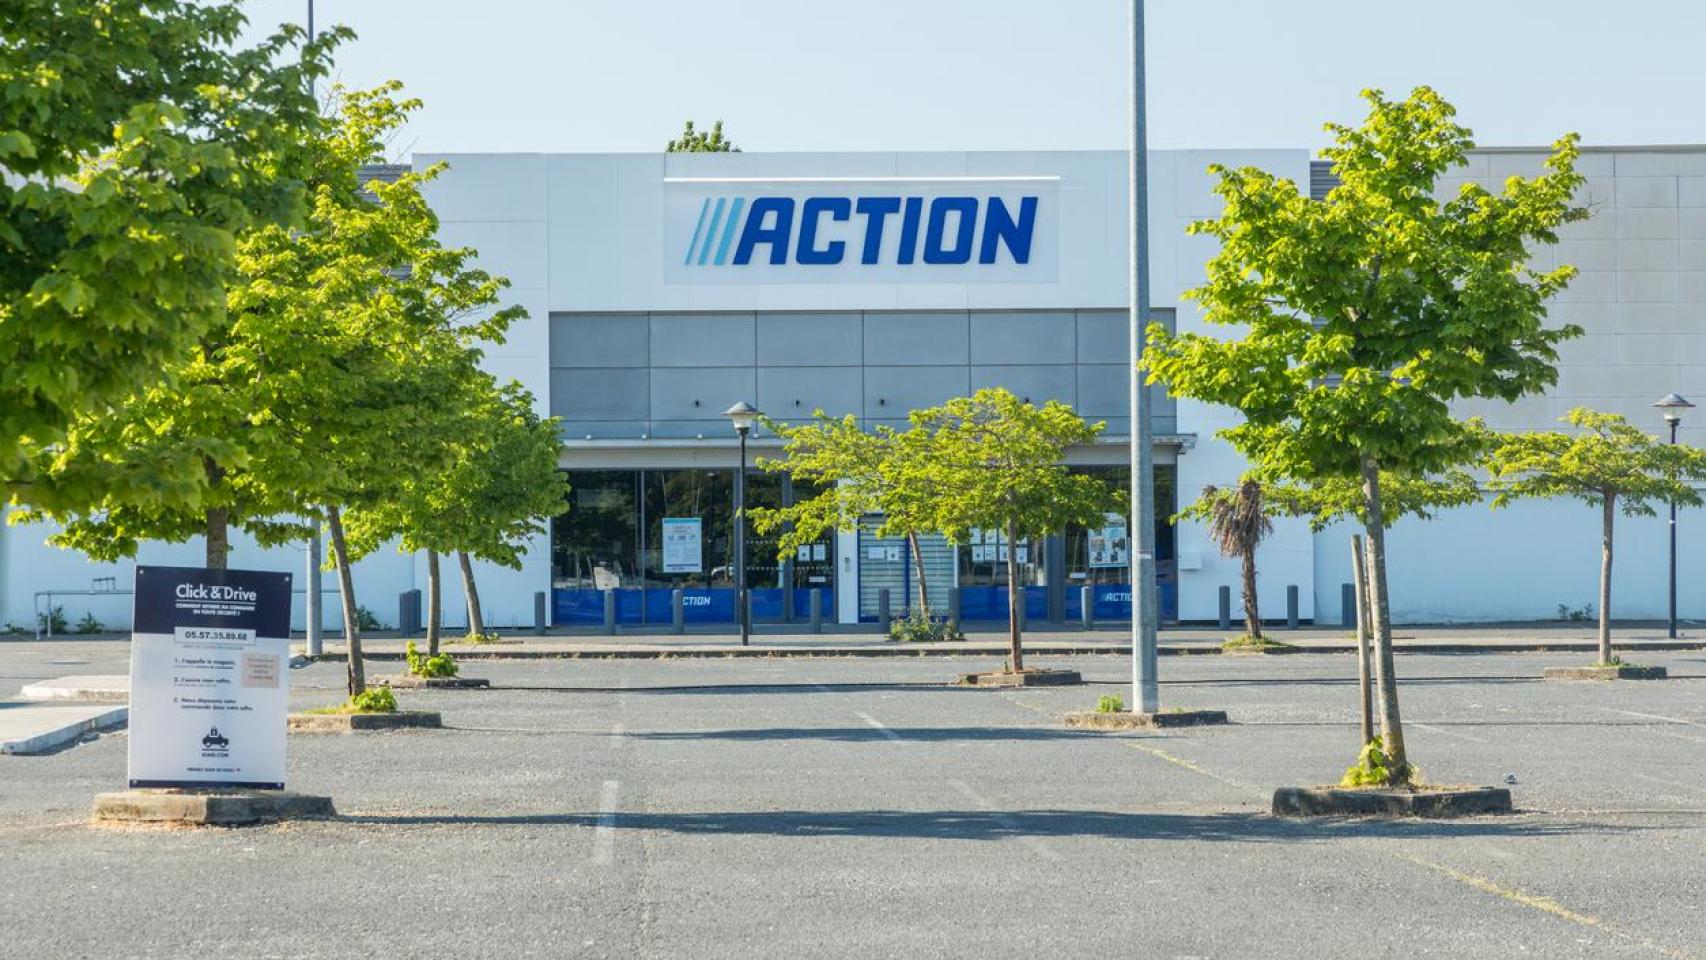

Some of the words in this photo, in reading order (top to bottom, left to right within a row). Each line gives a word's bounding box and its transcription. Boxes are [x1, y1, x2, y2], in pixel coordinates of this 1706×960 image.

[732, 197, 1038, 265] ACTION
[176, 583, 208, 598] Click
[210, 586, 222, 599] &
[224, 586, 257, 601] Drive
[682, 596, 711, 606] CTION
